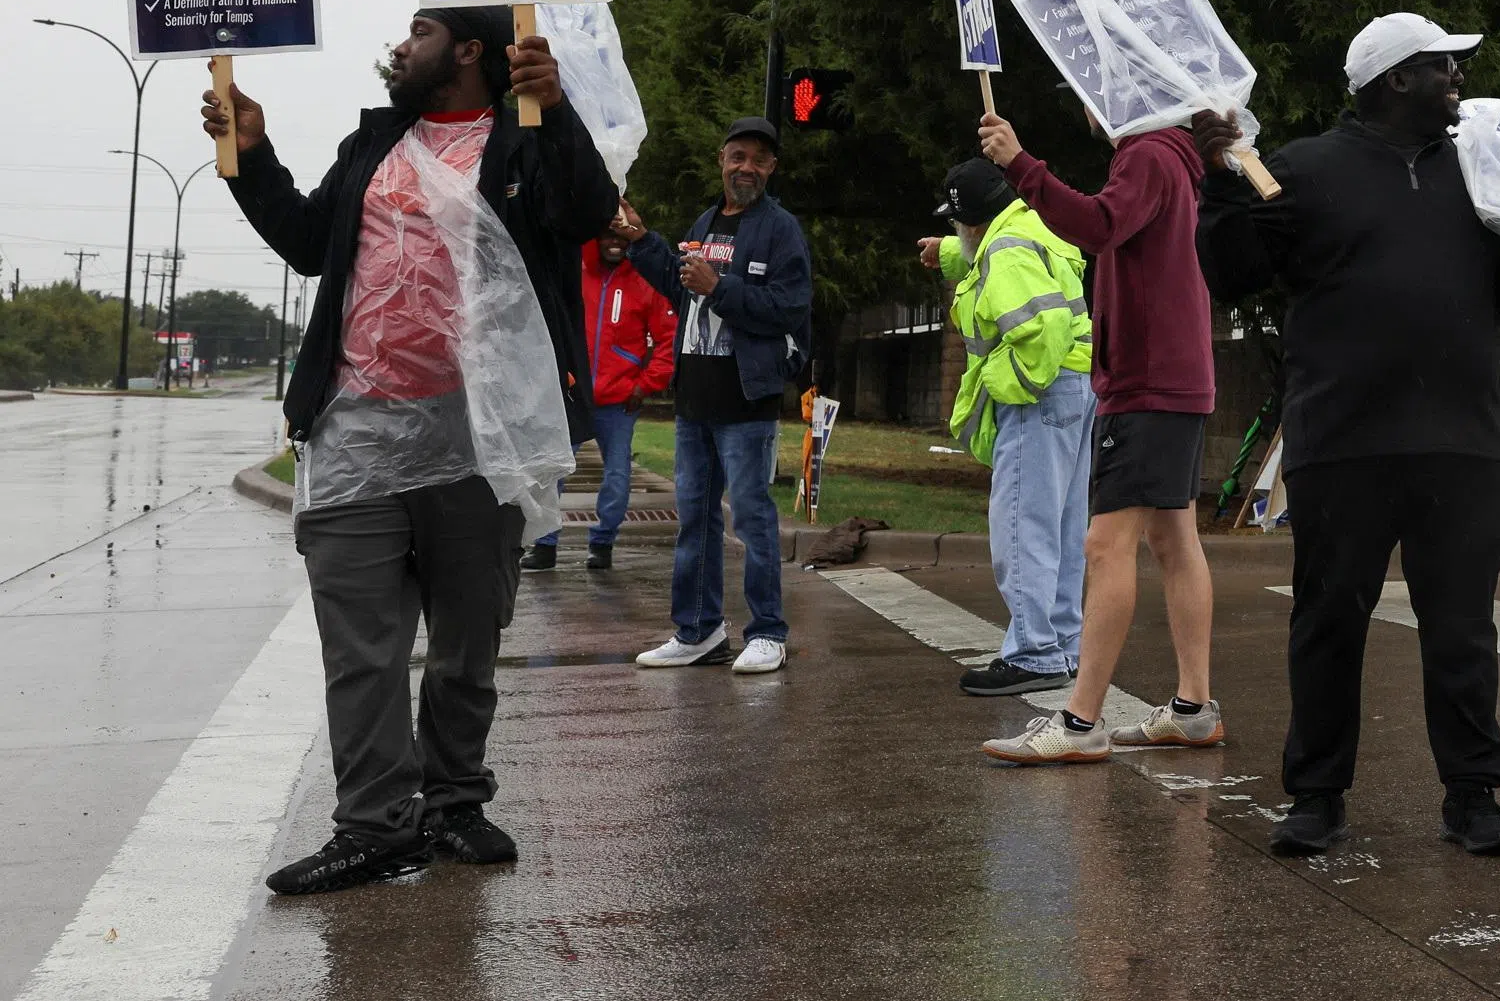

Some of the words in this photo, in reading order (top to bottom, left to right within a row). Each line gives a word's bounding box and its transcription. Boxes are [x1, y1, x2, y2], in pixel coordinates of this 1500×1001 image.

[165, 11, 208, 27] Seniority
[210, 10, 223, 24] for
[226, 9, 254, 25] Temps
